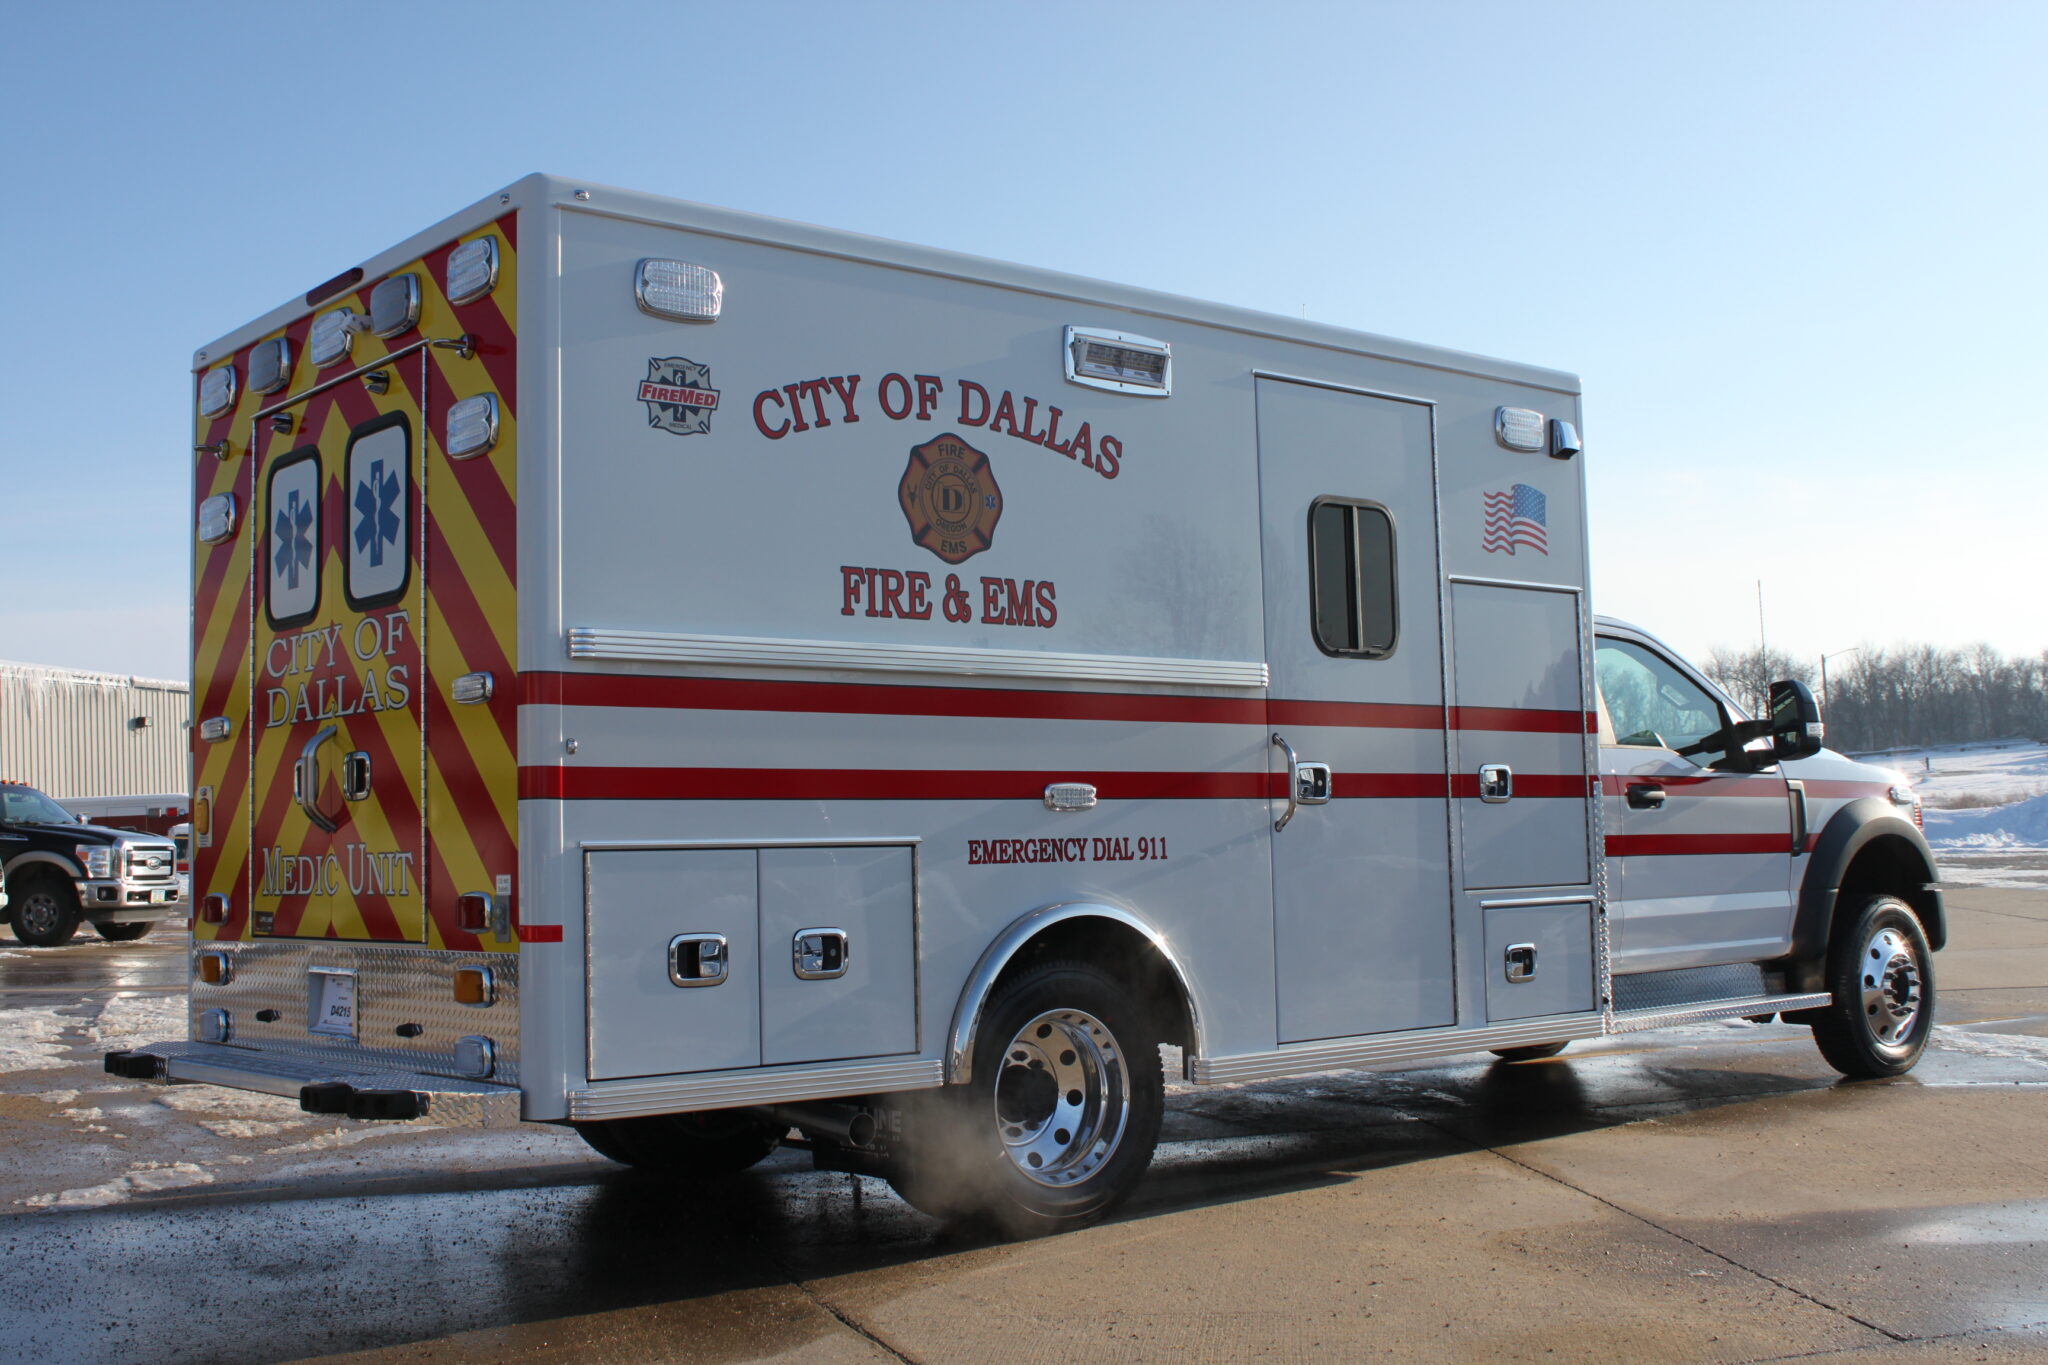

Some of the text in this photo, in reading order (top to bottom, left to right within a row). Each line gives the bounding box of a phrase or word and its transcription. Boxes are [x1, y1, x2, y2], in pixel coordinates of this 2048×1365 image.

[752, 372, 1123, 480] CITY OF DALLAS
[937, 443, 966, 460] FIRE
[939, 463, 950, 474] OF
[940, 539, 968, 555] EMS
[839, 565, 1059, 629] FIRE & EMS
[265, 609, 411, 679] CITY OF
[265, 664, 411, 729] DALLAS
[261, 842, 415, 897] MEDIC UNIT
[967, 836, 1169, 865] EMERGENCY DIAL 911
[330, 1004, 352, 1018] D4215
